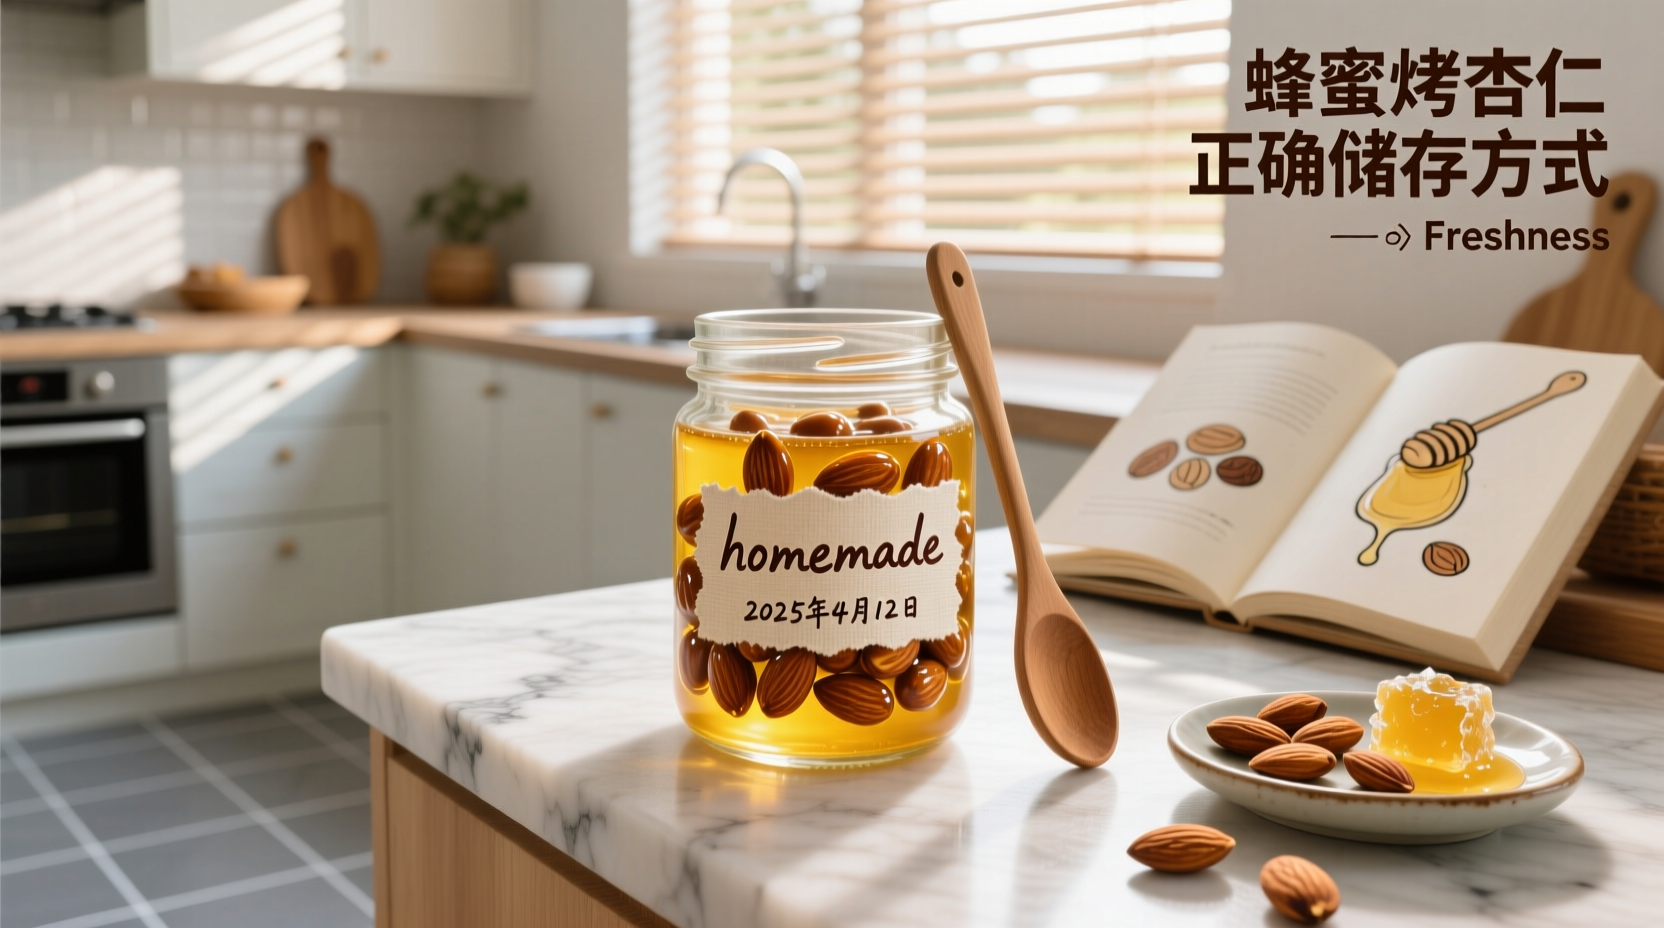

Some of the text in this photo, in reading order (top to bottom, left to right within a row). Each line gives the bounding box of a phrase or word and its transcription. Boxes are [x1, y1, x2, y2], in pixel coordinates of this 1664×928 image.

[720, 512, 944, 574] homemade
[743, 596, 918, 629] 2025年4月12日
